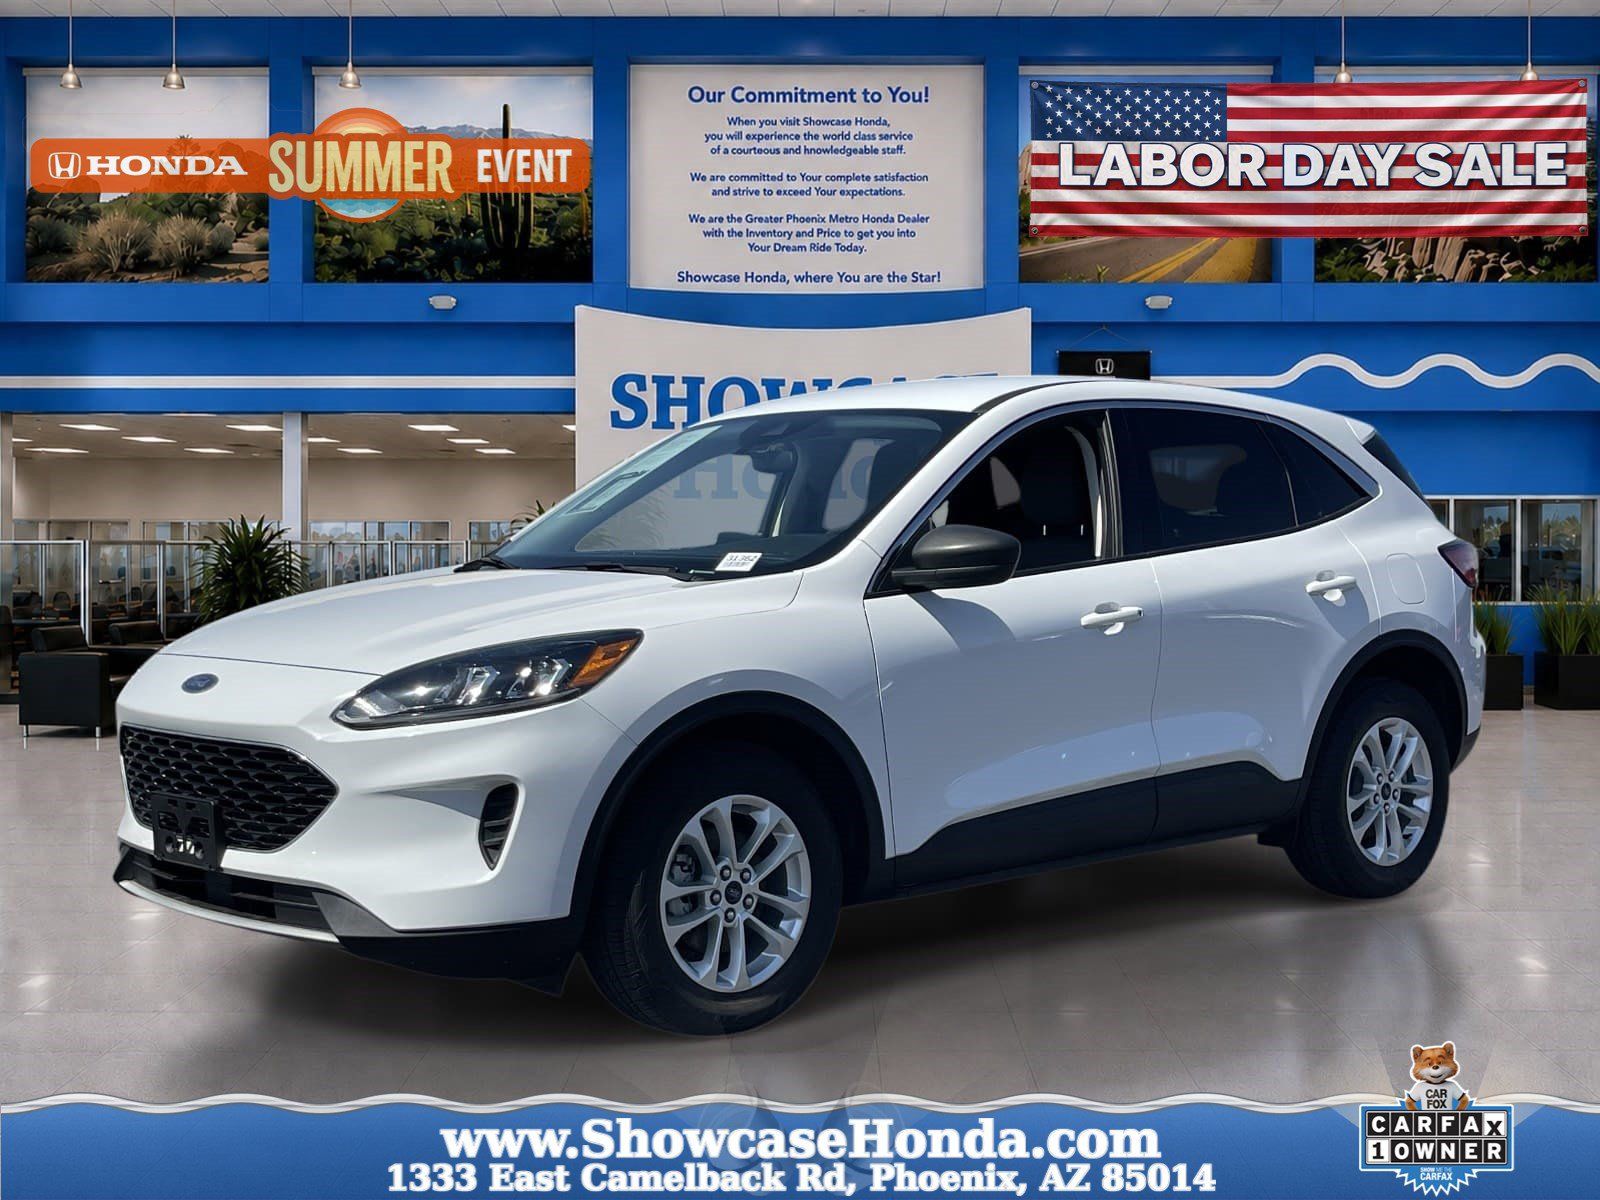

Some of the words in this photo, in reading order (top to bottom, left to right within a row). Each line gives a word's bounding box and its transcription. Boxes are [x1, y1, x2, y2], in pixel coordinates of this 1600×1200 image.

[688, 85, 726, 103] Our
[731, 86, 857, 104] Commitment
[861, 88, 882, 103] to
[887, 86, 929, 103] You!
[727, 116, 756, 126] When
[759, 119, 777, 129] you
[779, 116, 801, 126] visit
[802, 116, 852, 127] Showcase
[855, 116, 890, 128] Honda,
[704, 133, 723, 143] you
[725, 130, 743, 141] will
[745, 131, 801, 143] experience
[803, 131, 820, 141] the
[822, 130, 851, 141] world
[853, 131, 877, 141] class
[878, 131, 913, 141] service
[710, 144, 721, 155] of
[722, 147, 729, 155] a
[783, 145, 802, 155] and
[690, 172, 707, 182] We
[728, 172, 783, 182] committed
[786, 173, 797, 182] to
[799, 172, 822, 182] Your
[825, 172, 872, 185] complete
[873, 172, 929, 182] satisfaction
[711, 186, 731, 196] and
[732, 186, 760, 197] strive
[763, 188, 774, 196] to
[776, 186, 812, 196] exceed
[814, 186, 837, 196] Your
[839, 186, 905, 199] expectations.
[688, 214, 706, 224] We
[707, 216, 724, 224] are
[726, 213, 743, 224] the
[745, 213, 784, 224] Greater
[786, 213, 826, 224] Phoenix
[829, 214, 859, 224] Metro
[862, 213, 895, 224] Honda
[897, 213, 930, 224] Dealer
[702, 227, 725, 238] with
[727, 227, 744, 238] the
[746, 228, 793, 240] Inventory
[795, 227, 814, 238] and
[816, 228, 842, 238] Price
[844, 229, 855, 238] to
[857, 229, 874, 241] get
[876, 230, 895, 240] you
[897, 228, 916, 238] into
[747, 242, 771, 252] Your
[773, 242, 807, 252] Dream
[809, 242, 832, 252] Ride
[834, 242, 867, 255] Today.
[677, 270, 740, 283] Showcase
[744, 271, 790, 285] Honda,
[793, 271, 834, 283] where
[837, 272, 860, 283] You
[864, 274, 884, 283] are
[886, 271, 908, 283] the
[911, 271, 941, 283] Star!
